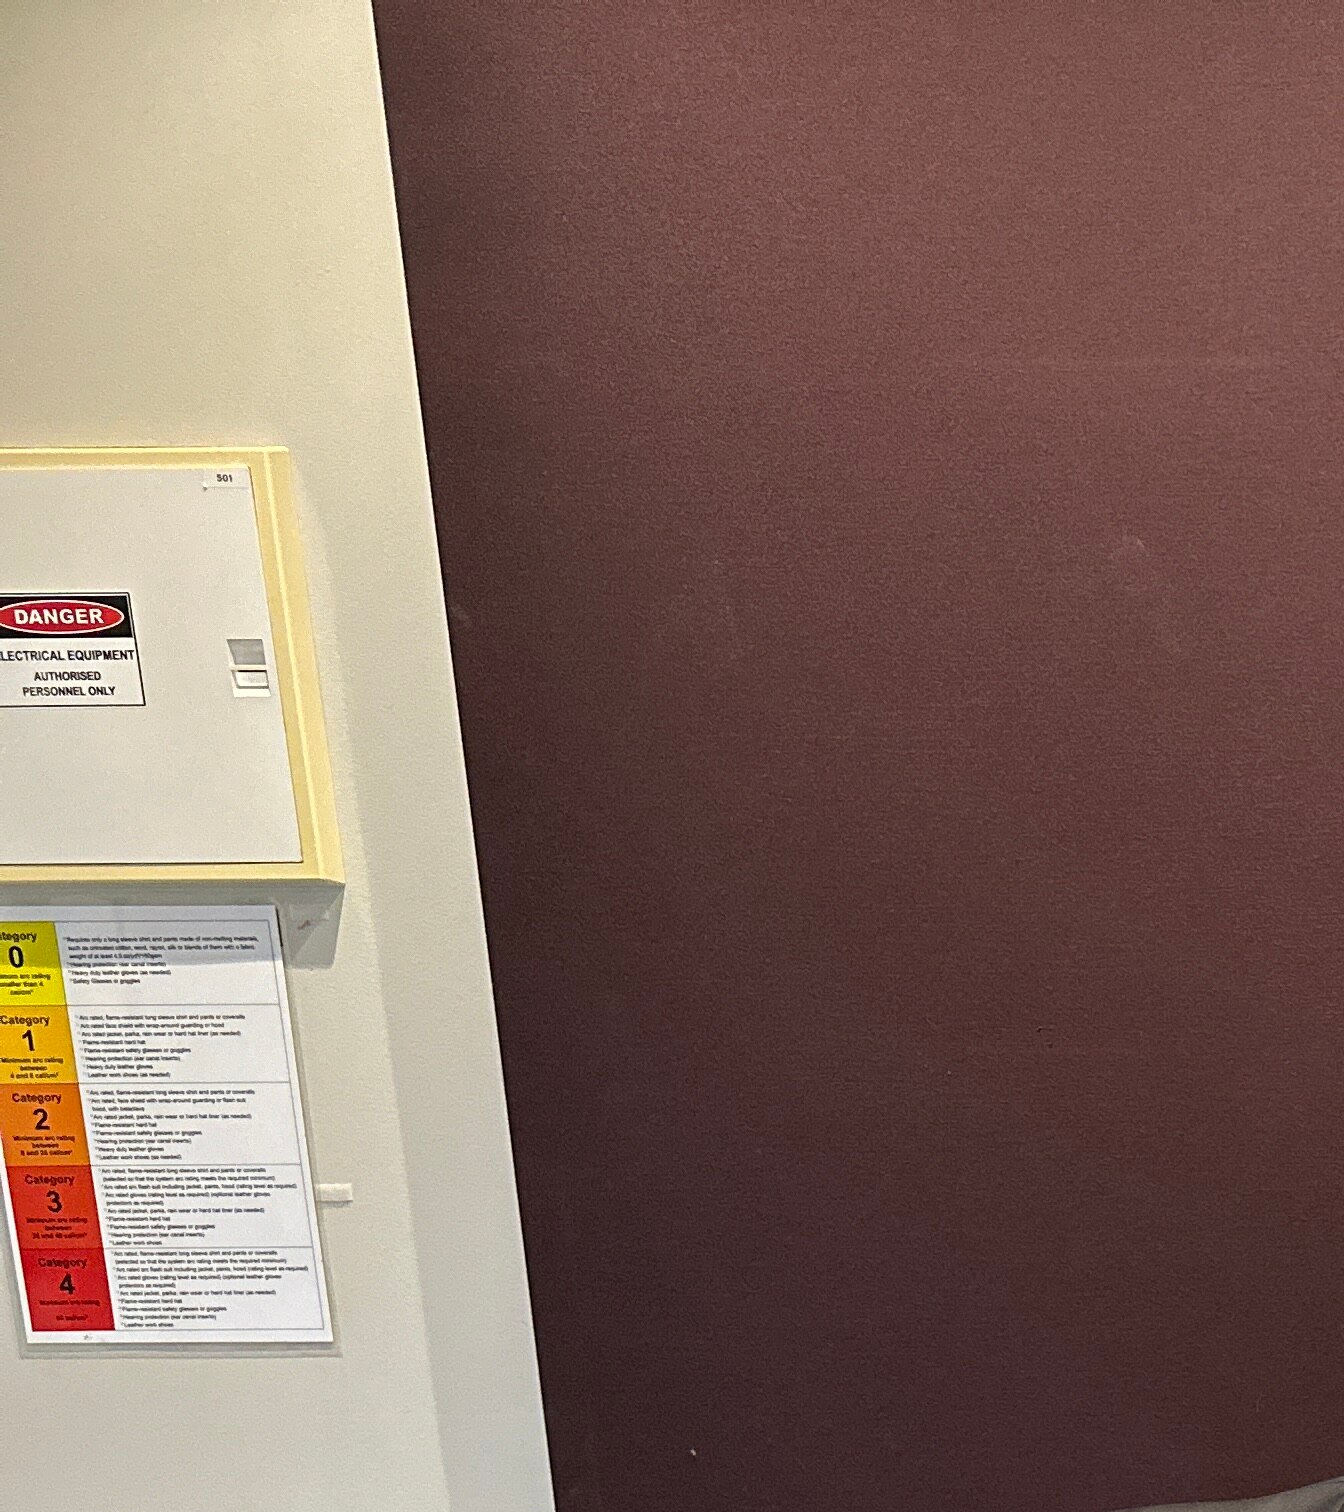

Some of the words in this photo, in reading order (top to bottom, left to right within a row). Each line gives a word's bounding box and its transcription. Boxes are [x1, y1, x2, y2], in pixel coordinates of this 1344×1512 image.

[14, 608, 104, 625] DANGER
[0, 650, 65, 661] LECTRICAL
[67, 650, 134, 661] EQUIPMENT
[34, 672, 101, 681] AUTHORISED
[22, 686, 86, 697] PERSONNEL
[88, 686, 115, 696] ONLY
[9, 946, 24, 968] 0
[0, 1015, 50, 1026] Category
[22, 1030, 35, 1051] 1
[12, 1092, 61, 1104] Category
[33, 1108, 50, 1130] 2
[25, 1174, 75, 1186] Category
[46, 1190, 62, 1213] 3
[38, 1258, 87, 1269] Category
[59, 1274, 75, 1294] 4
